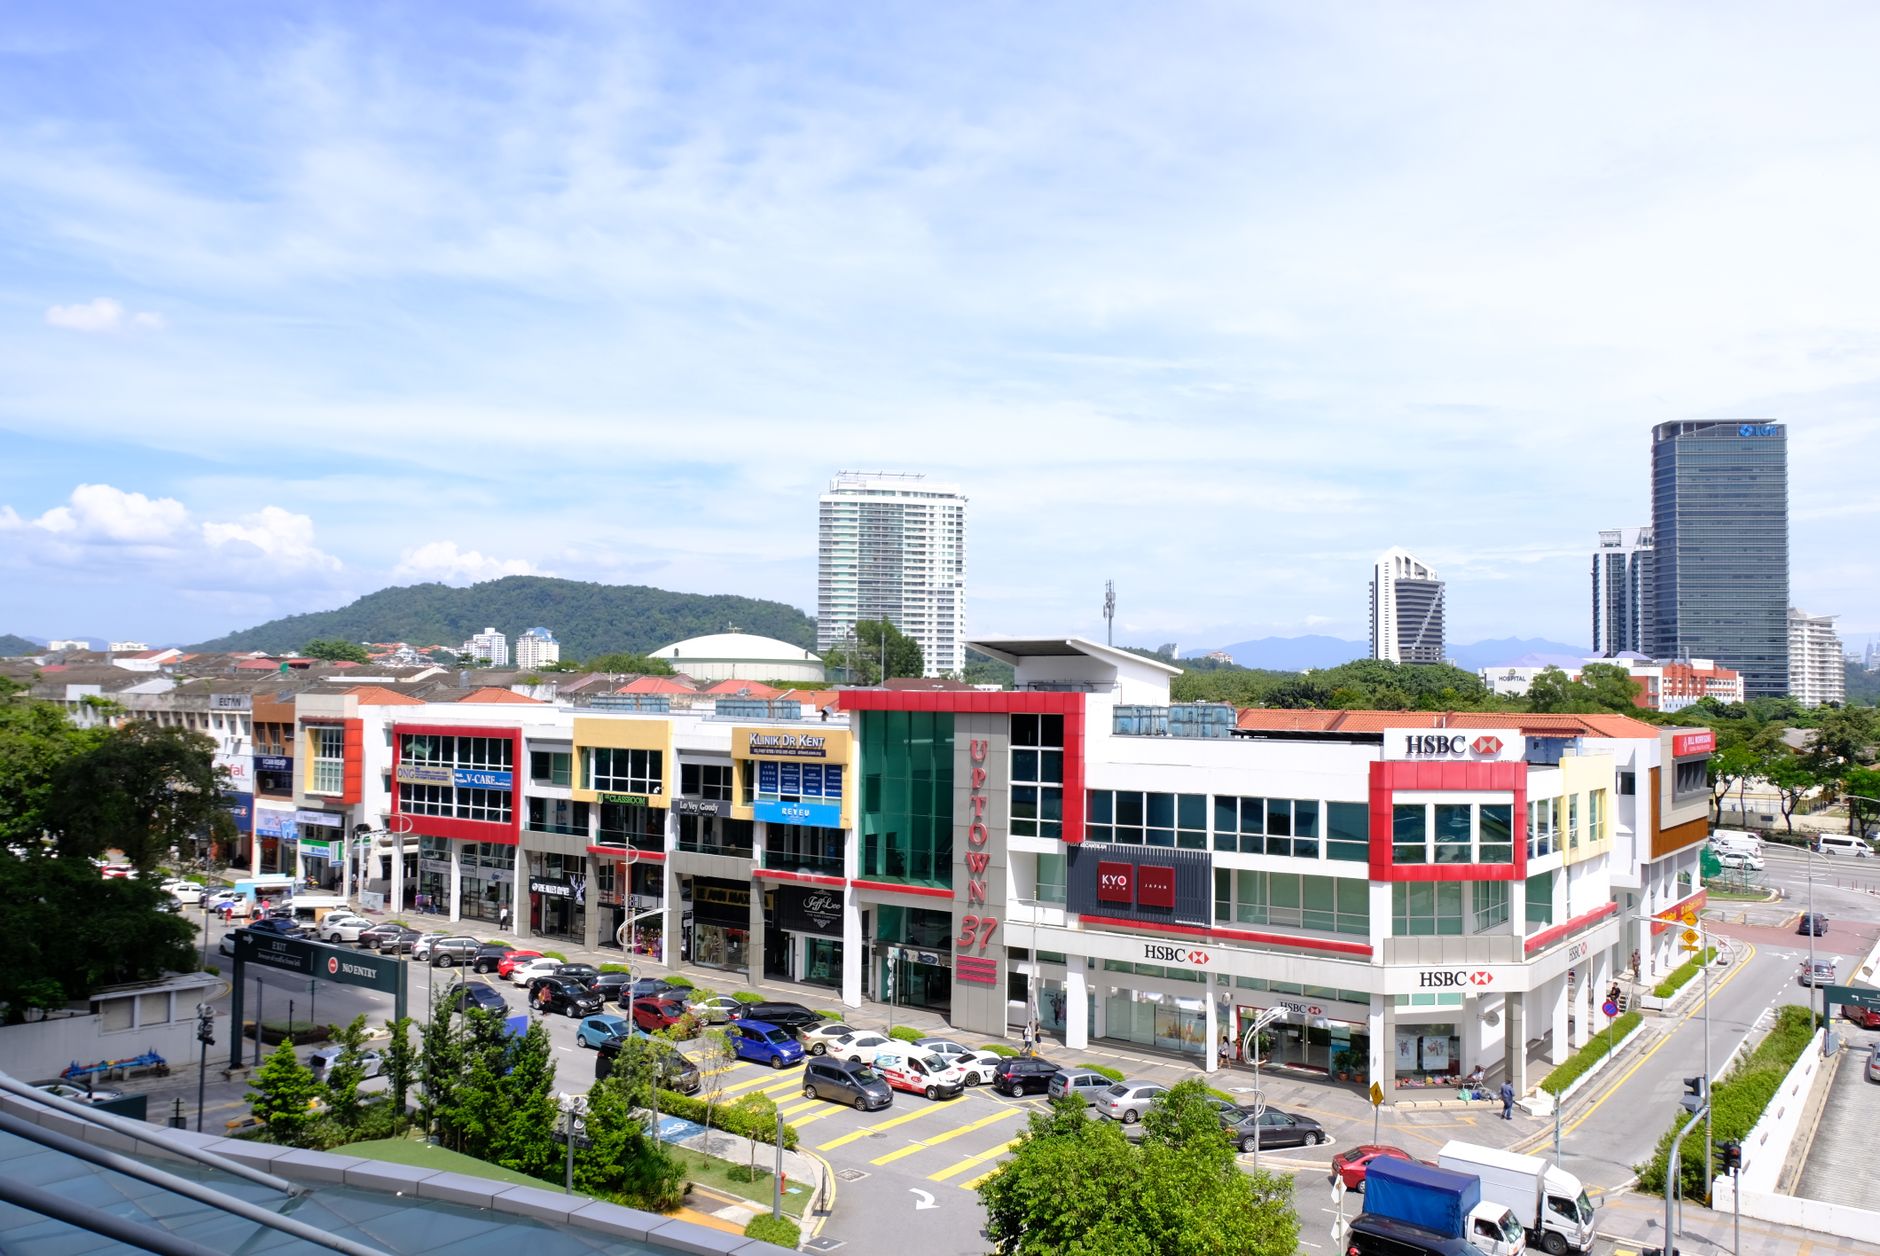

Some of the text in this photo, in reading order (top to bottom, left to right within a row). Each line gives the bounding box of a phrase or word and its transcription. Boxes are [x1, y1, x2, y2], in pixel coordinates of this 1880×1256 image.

[749, 733, 825, 747] KLINIK DR KENT
[1405, 735, 1466, 754] HSBC
[466, 773, 496, 785] V-CARE
[966, 739, 990, 905] UPTOWN
[1102, 874, 1127, 886] KYO
[957, 915, 998, 949] 37
[272, 940, 287, 952] EXIT
[1144, 944, 1186, 962] HSBC
[342, 963, 377, 979] NO ENTRY
[1419, 971, 1467, 987] HSBC
[1280, 1001, 1307, 1014] HSBC
